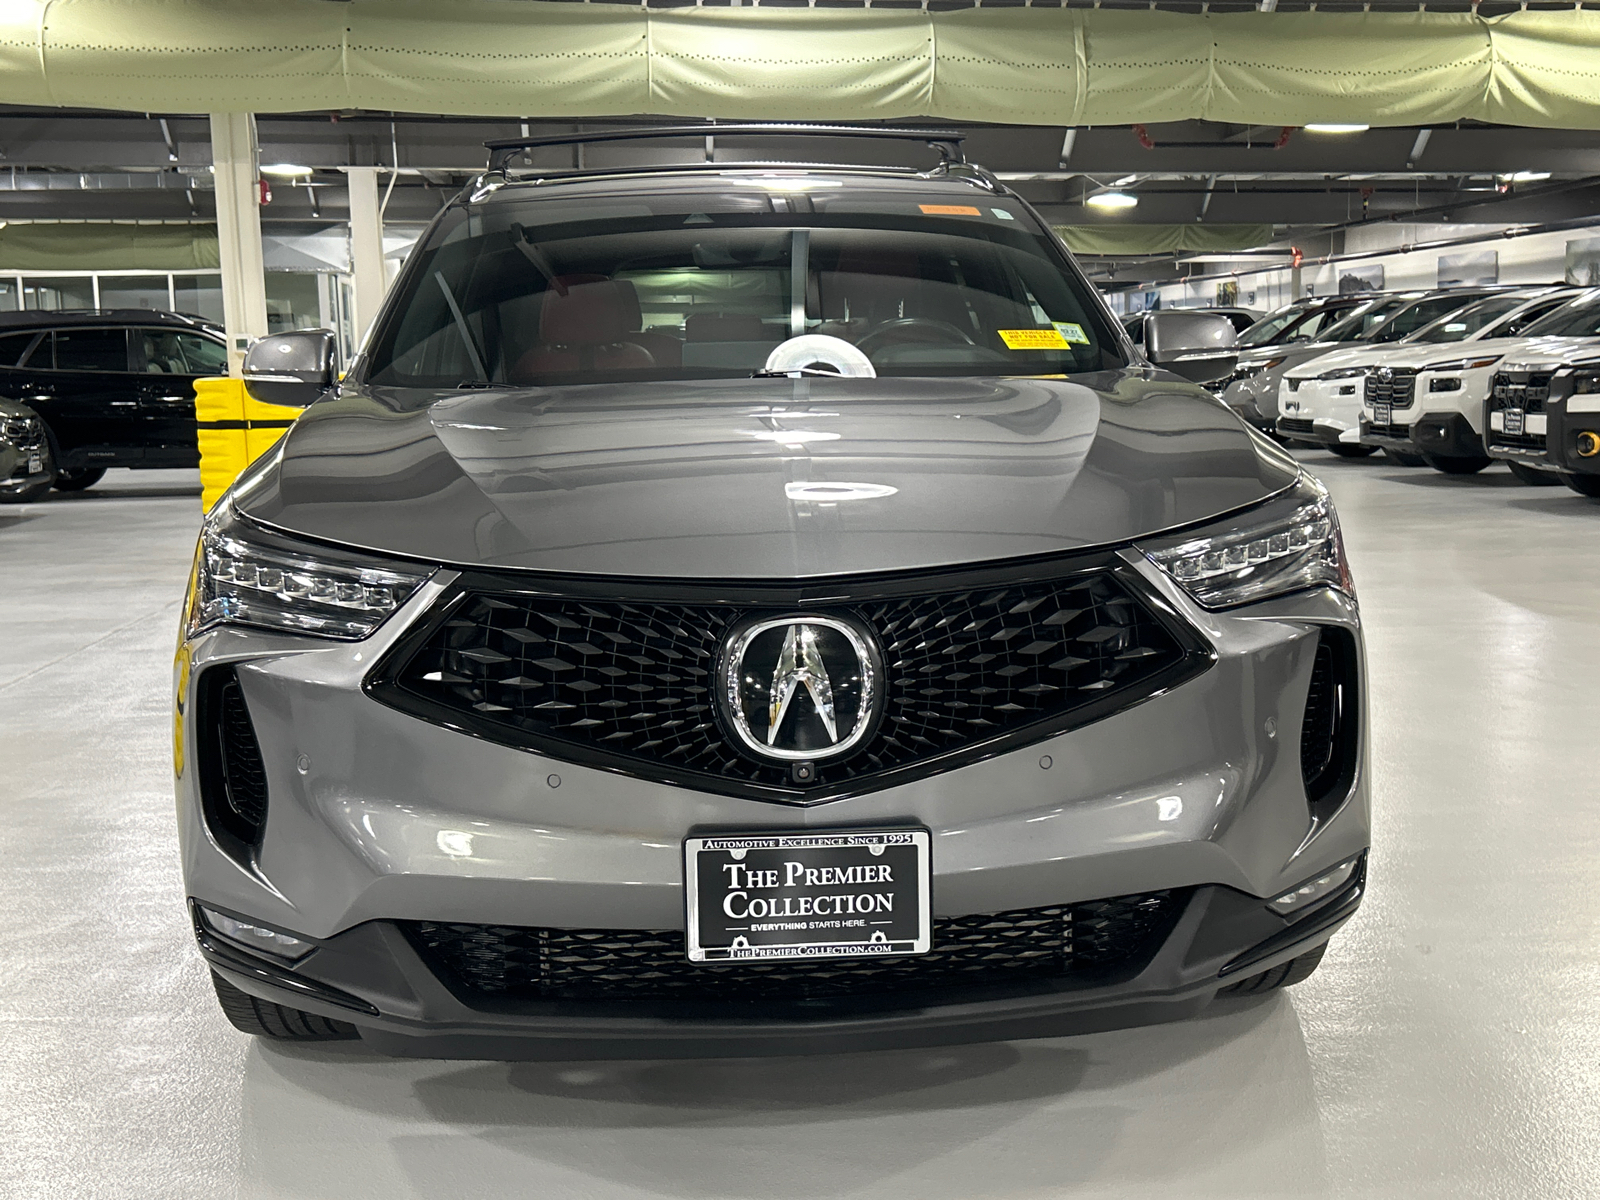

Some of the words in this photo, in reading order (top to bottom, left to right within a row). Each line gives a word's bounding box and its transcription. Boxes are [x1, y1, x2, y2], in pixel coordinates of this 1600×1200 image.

[882, 834, 911, 844] 1995
[723, 863, 780, 889] THE
[783, 862, 894, 887] PREMIER
[722, 892, 895, 919] COLLECTION
[750, 922, 808, 932] EVERYTHING
[808, 920, 841, 930] STARTS
[842, 919, 868, 928] HERE.
